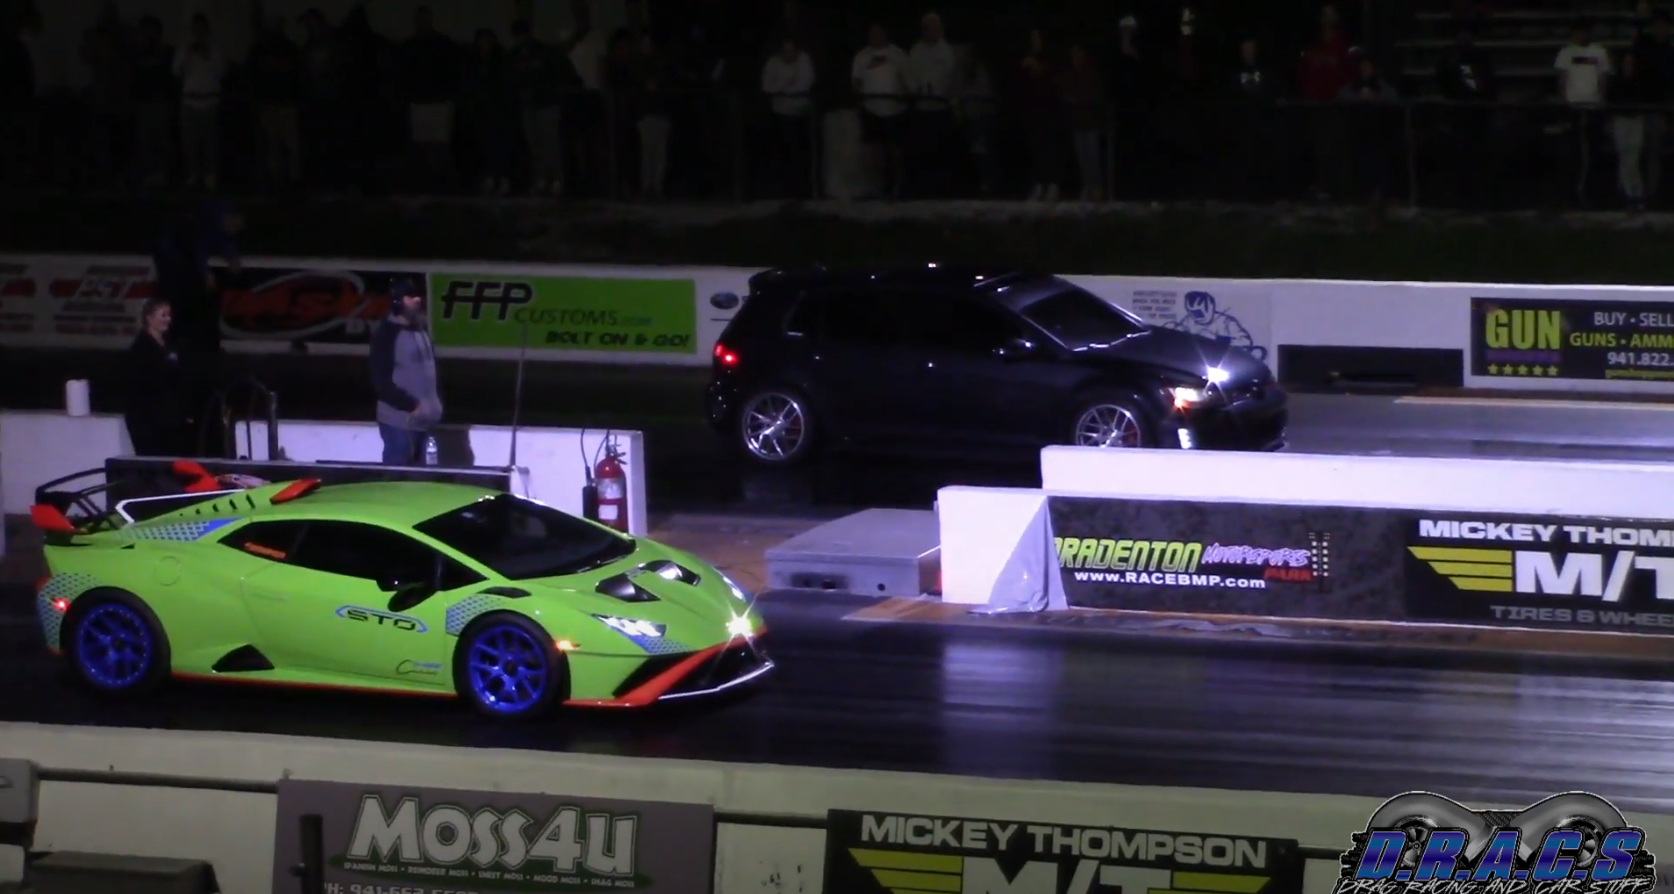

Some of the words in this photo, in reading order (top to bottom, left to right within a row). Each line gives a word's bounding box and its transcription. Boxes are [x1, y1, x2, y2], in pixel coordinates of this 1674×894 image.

[440, 281, 532, 321] FFP
[1486, 309, 1560, 350] GUN
[1594, 312, 1626, 326] BUY
[545, 330, 591, 345] BOLT
[599, 331, 627, 345] ON
[652, 333, 690, 347] GO!
[1569, 332, 1616, 347] GUNS
[1630, 334, 1674, 349] AMM
[1419, 519, 1557, 542] MICKEY
[1563, 525, 1674, 547] THOM
[1201, 543, 1312, 566] MOTORSPORTS
[1074, 571, 1266, 589] www.RACEBMP.com
[1515, 550, 1674, 602] M/T
[347, 609, 416, 631] STO
[1490, 605, 1572, 622] TIRES
[861, 815, 1019, 851] MICKEY
[1027, 826, 1267, 868] THOMPSON
